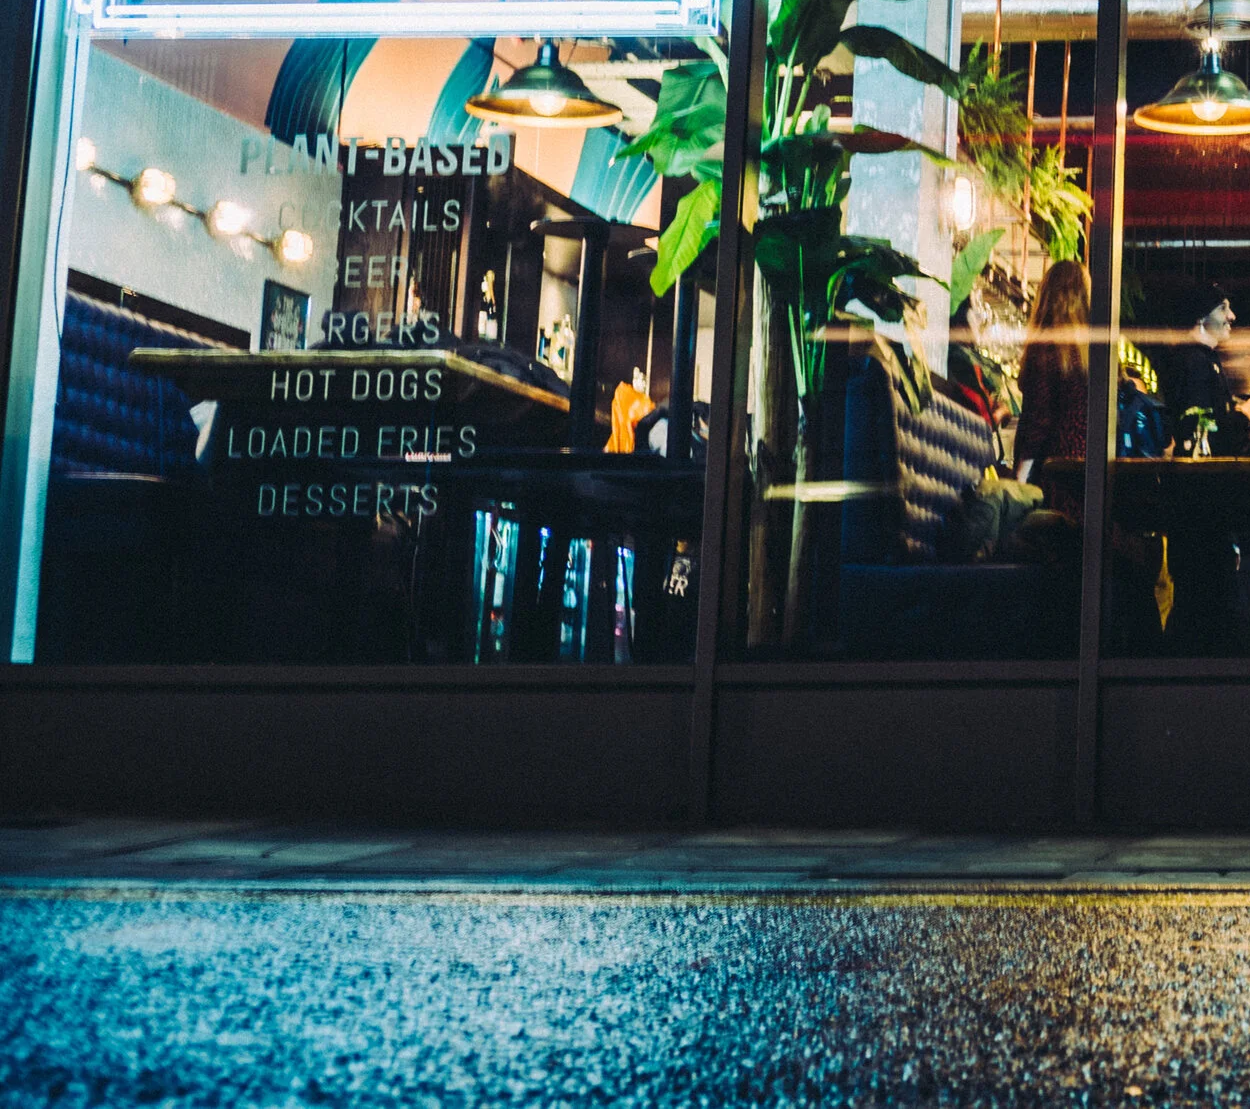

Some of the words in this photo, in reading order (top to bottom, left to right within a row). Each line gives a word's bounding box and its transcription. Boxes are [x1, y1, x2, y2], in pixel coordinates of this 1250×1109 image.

[240, 131, 513, 177] PLANT-BASED
[334, 255, 409, 288] EER
[328, 311, 441, 345] RGERS
[271, 369, 335, 401] HOT
[352, 369, 443, 401] DOGS
[228, 426, 360, 459] LOADED
[377, 426, 477, 459] FRIES
[258, 484, 438, 517] DESSERTS
